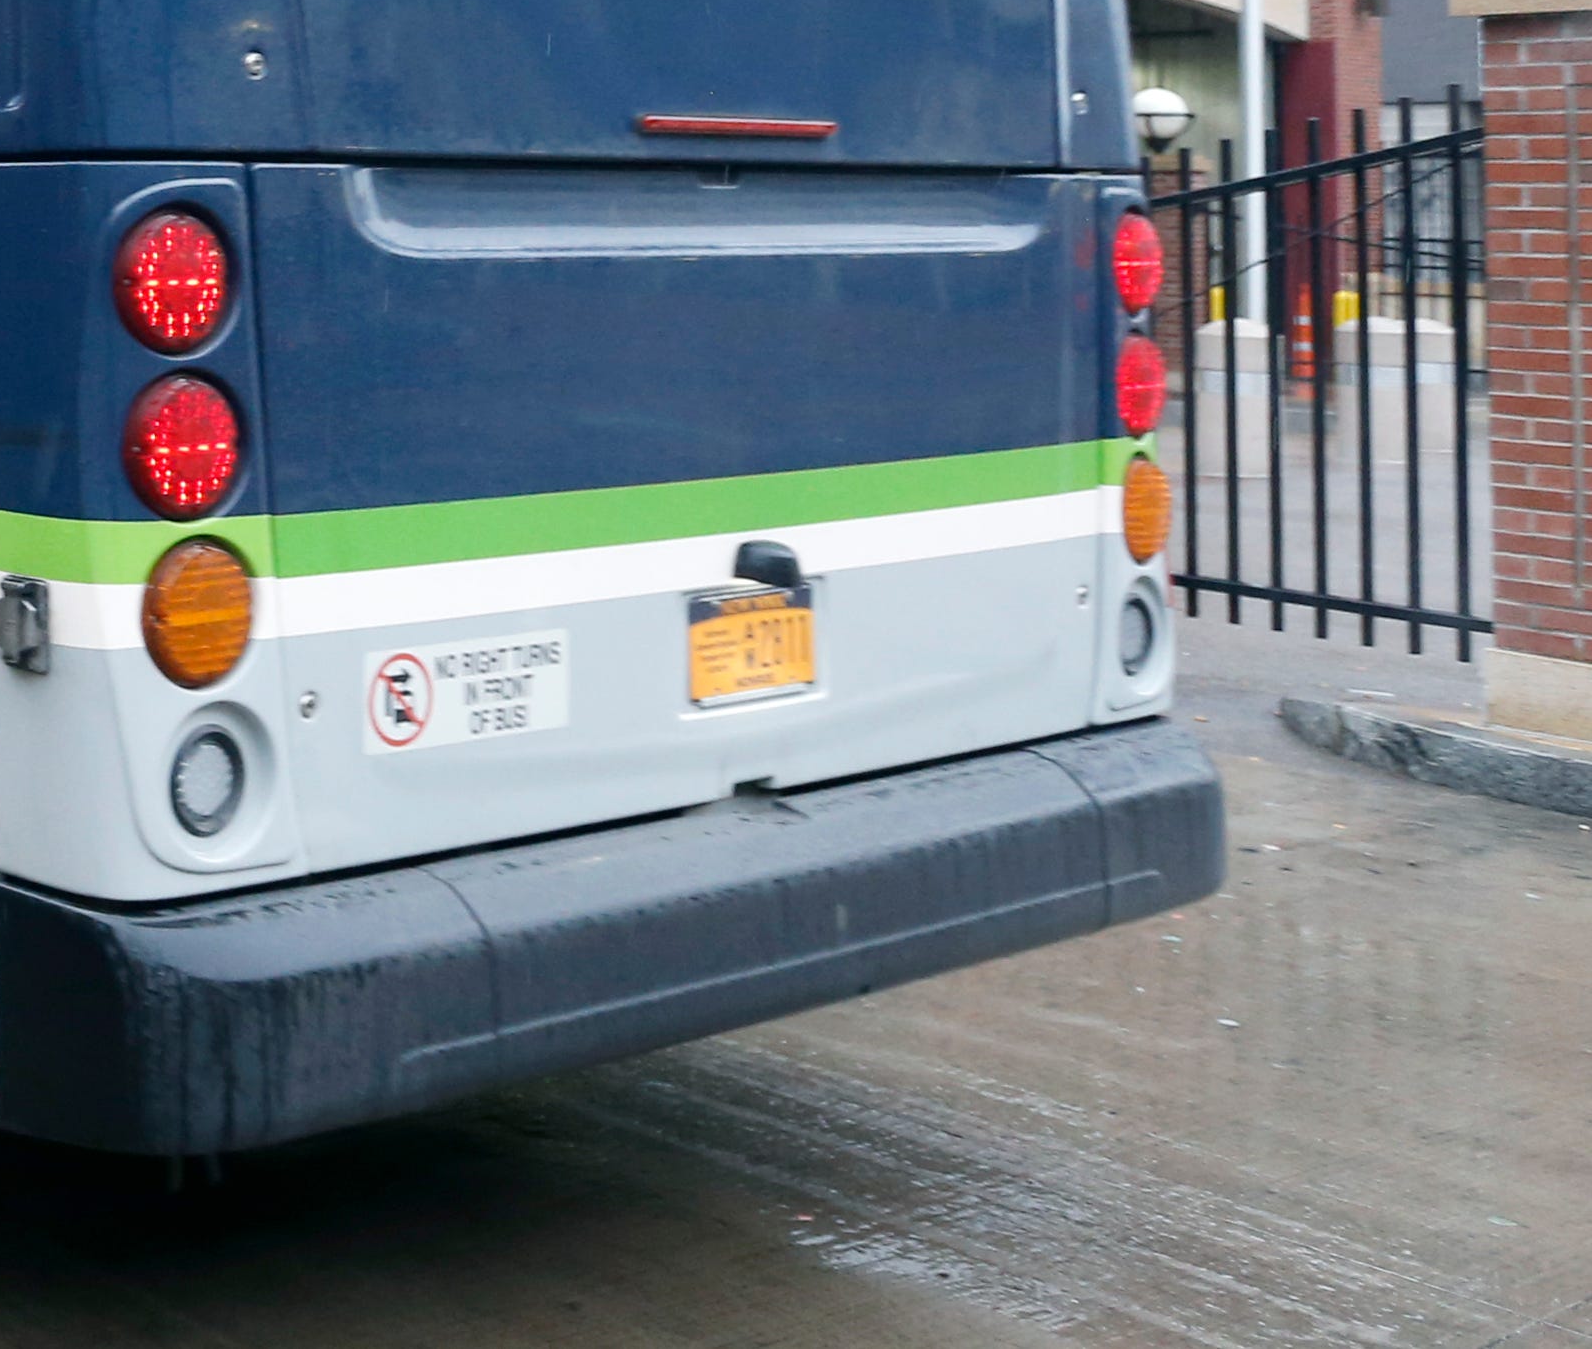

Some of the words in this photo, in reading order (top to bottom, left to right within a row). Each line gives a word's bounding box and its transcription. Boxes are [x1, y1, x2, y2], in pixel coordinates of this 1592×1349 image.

[434, 653, 456, 680] NO
[460, 648, 508, 676] RIGHT
[510, 641, 561, 669] TURNS
[482, 674, 535, 702] FRONT
